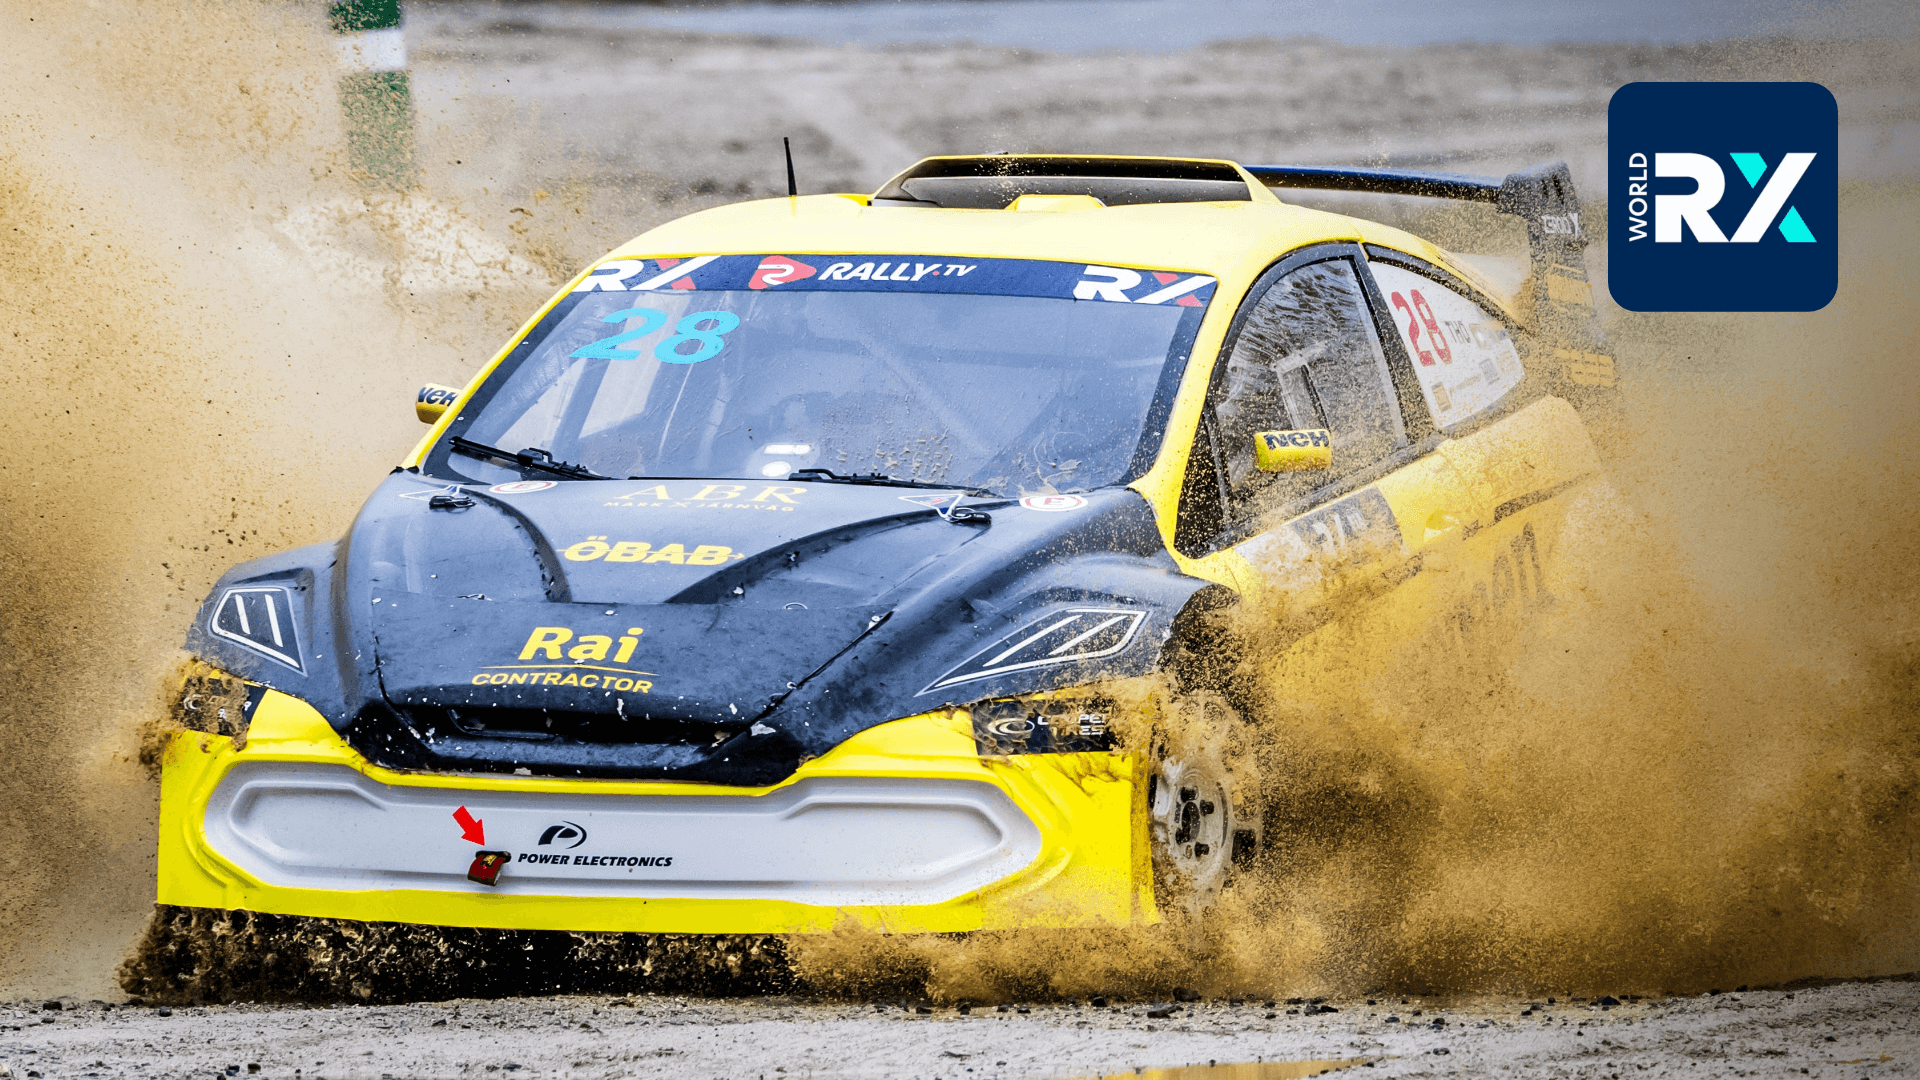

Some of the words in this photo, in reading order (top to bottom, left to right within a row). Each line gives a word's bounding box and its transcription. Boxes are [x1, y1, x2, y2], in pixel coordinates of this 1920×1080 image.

[568, 307, 741, 364] 28
[1391, 289, 1452, 367] 28
[612, 484, 808, 505] ABR
[563, 535, 733, 566] ÖBAB
[517, 626, 645, 664] Rai
[471, 672, 653, 694] CONTRACTOR
[518, 853, 570, 865] POWER
[573, 855, 673, 867] ELECTRONICS
